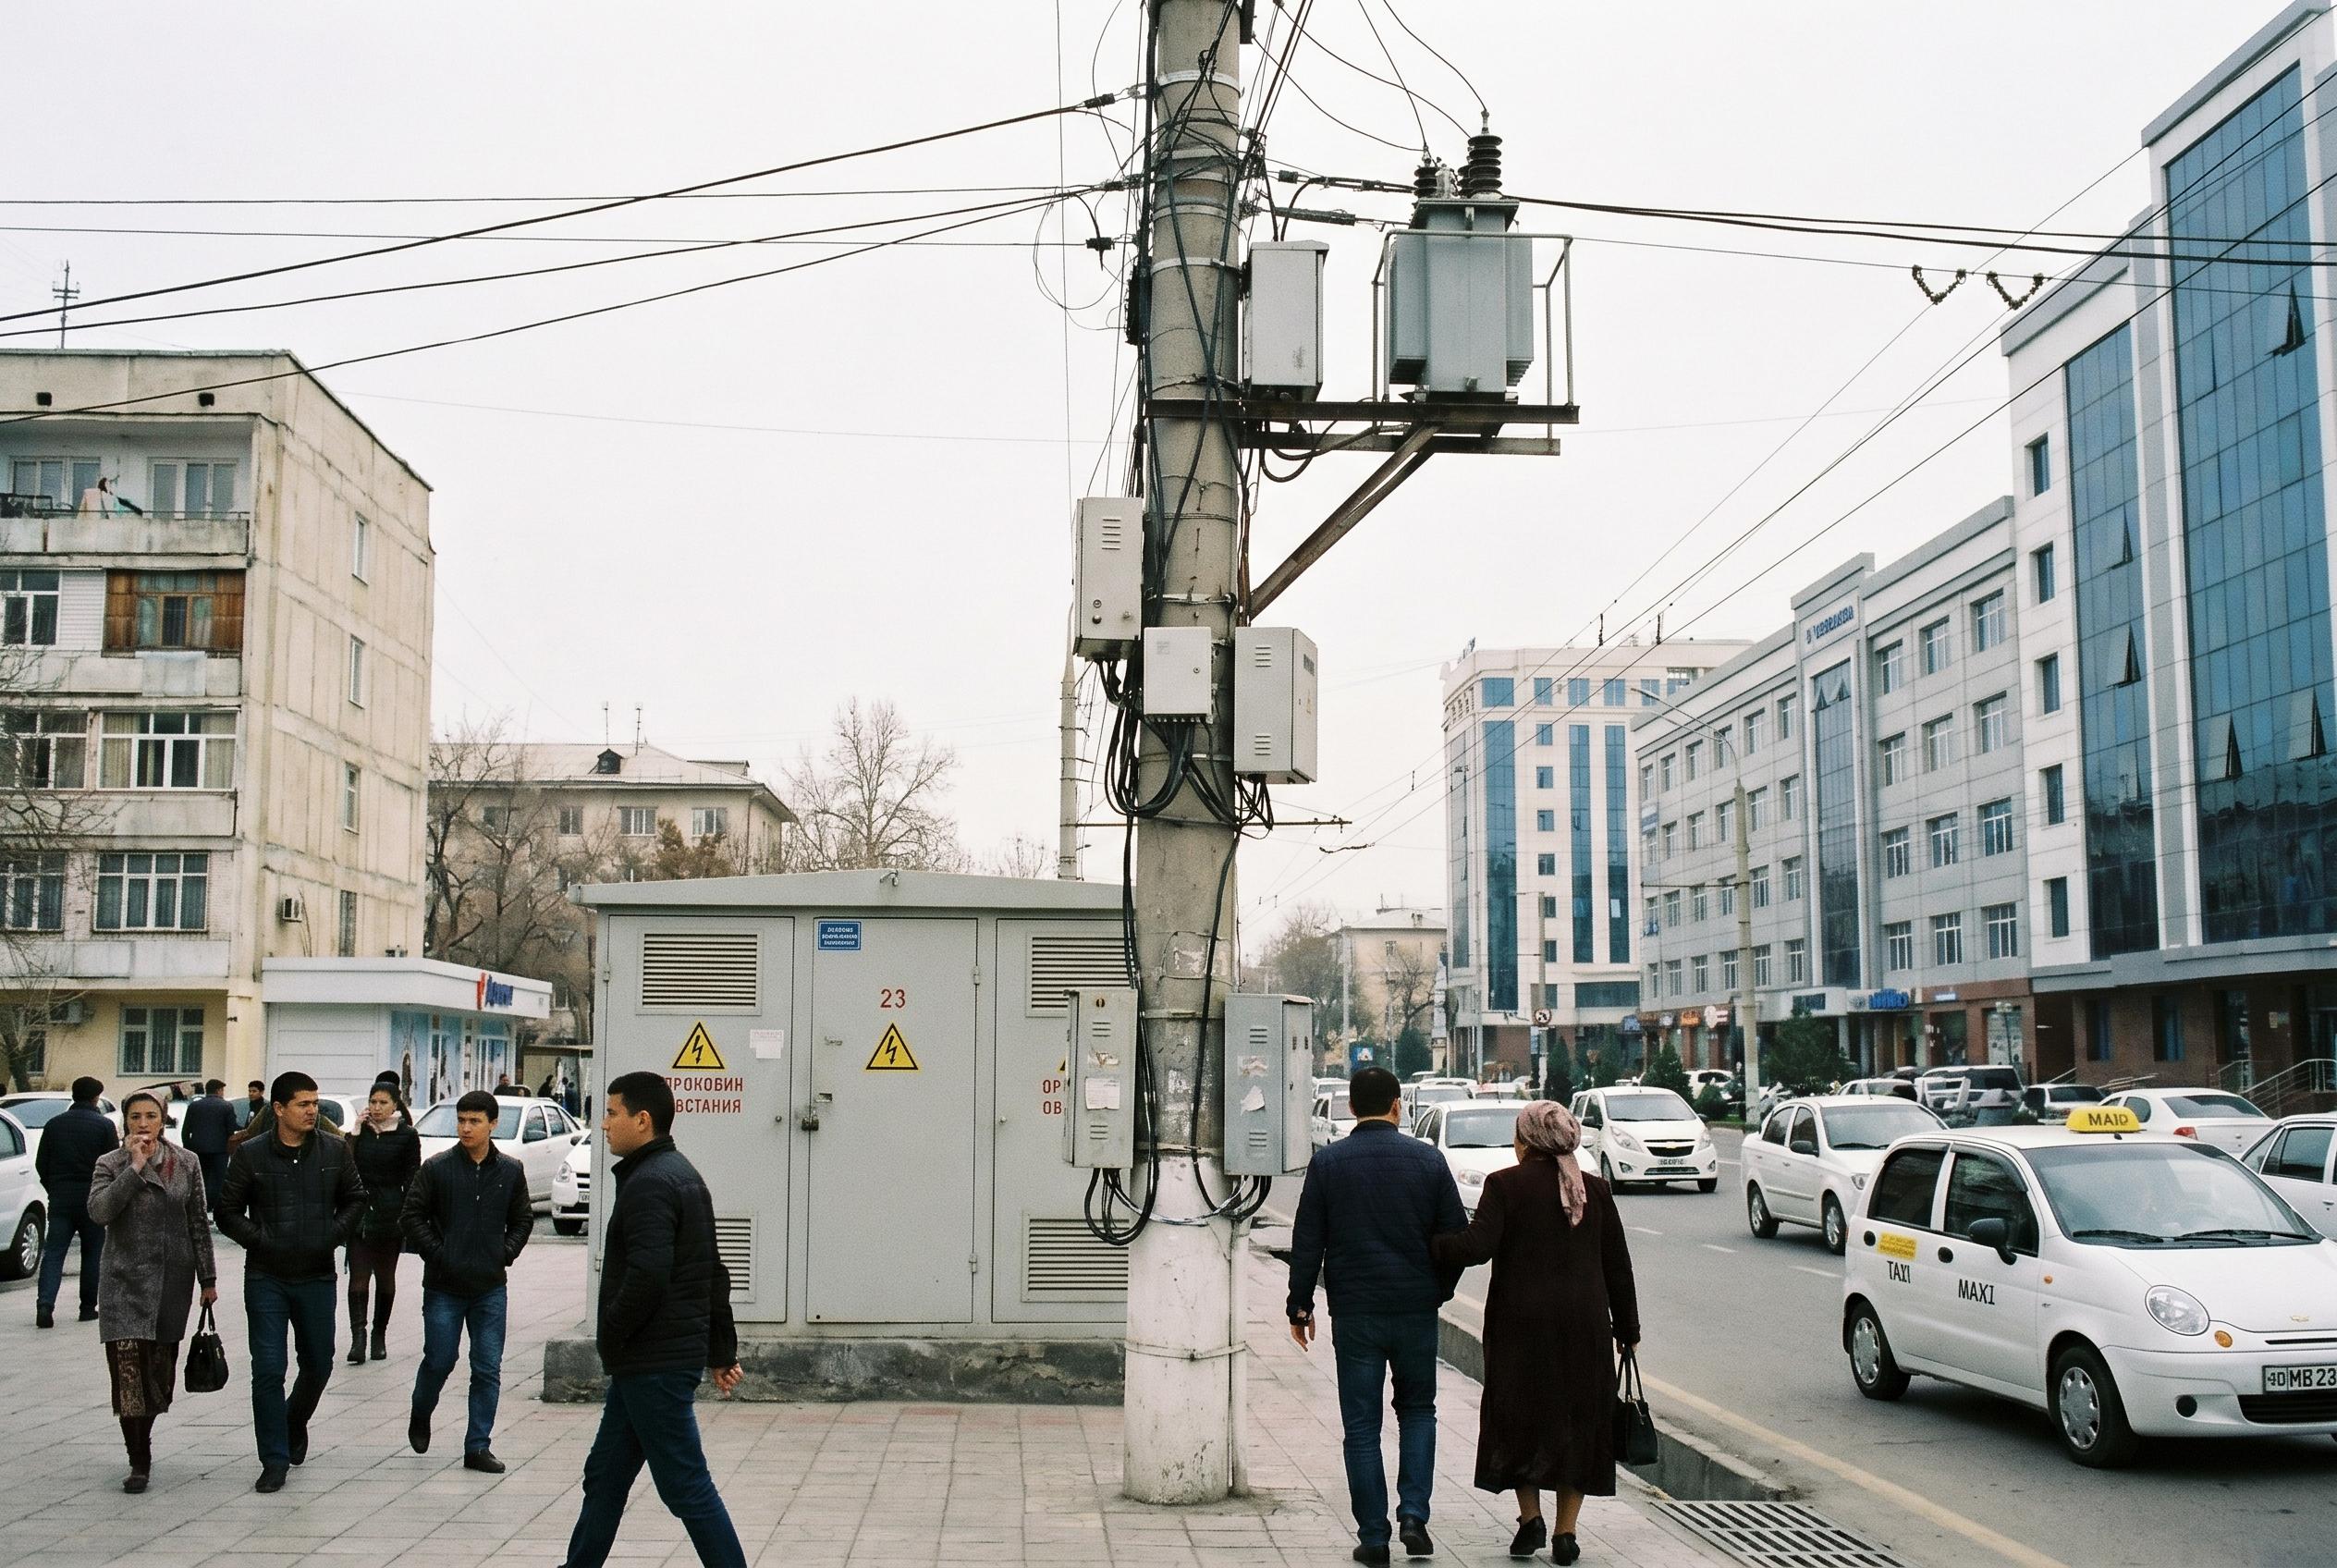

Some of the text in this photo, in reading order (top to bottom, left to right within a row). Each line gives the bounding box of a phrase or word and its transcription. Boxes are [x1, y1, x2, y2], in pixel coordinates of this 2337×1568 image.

[880, 988, 906, 1009] 23
[675, 1098, 741, 1113] ВСТАНИЯ
[1958, 1279, 1995, 1305] MAXI
